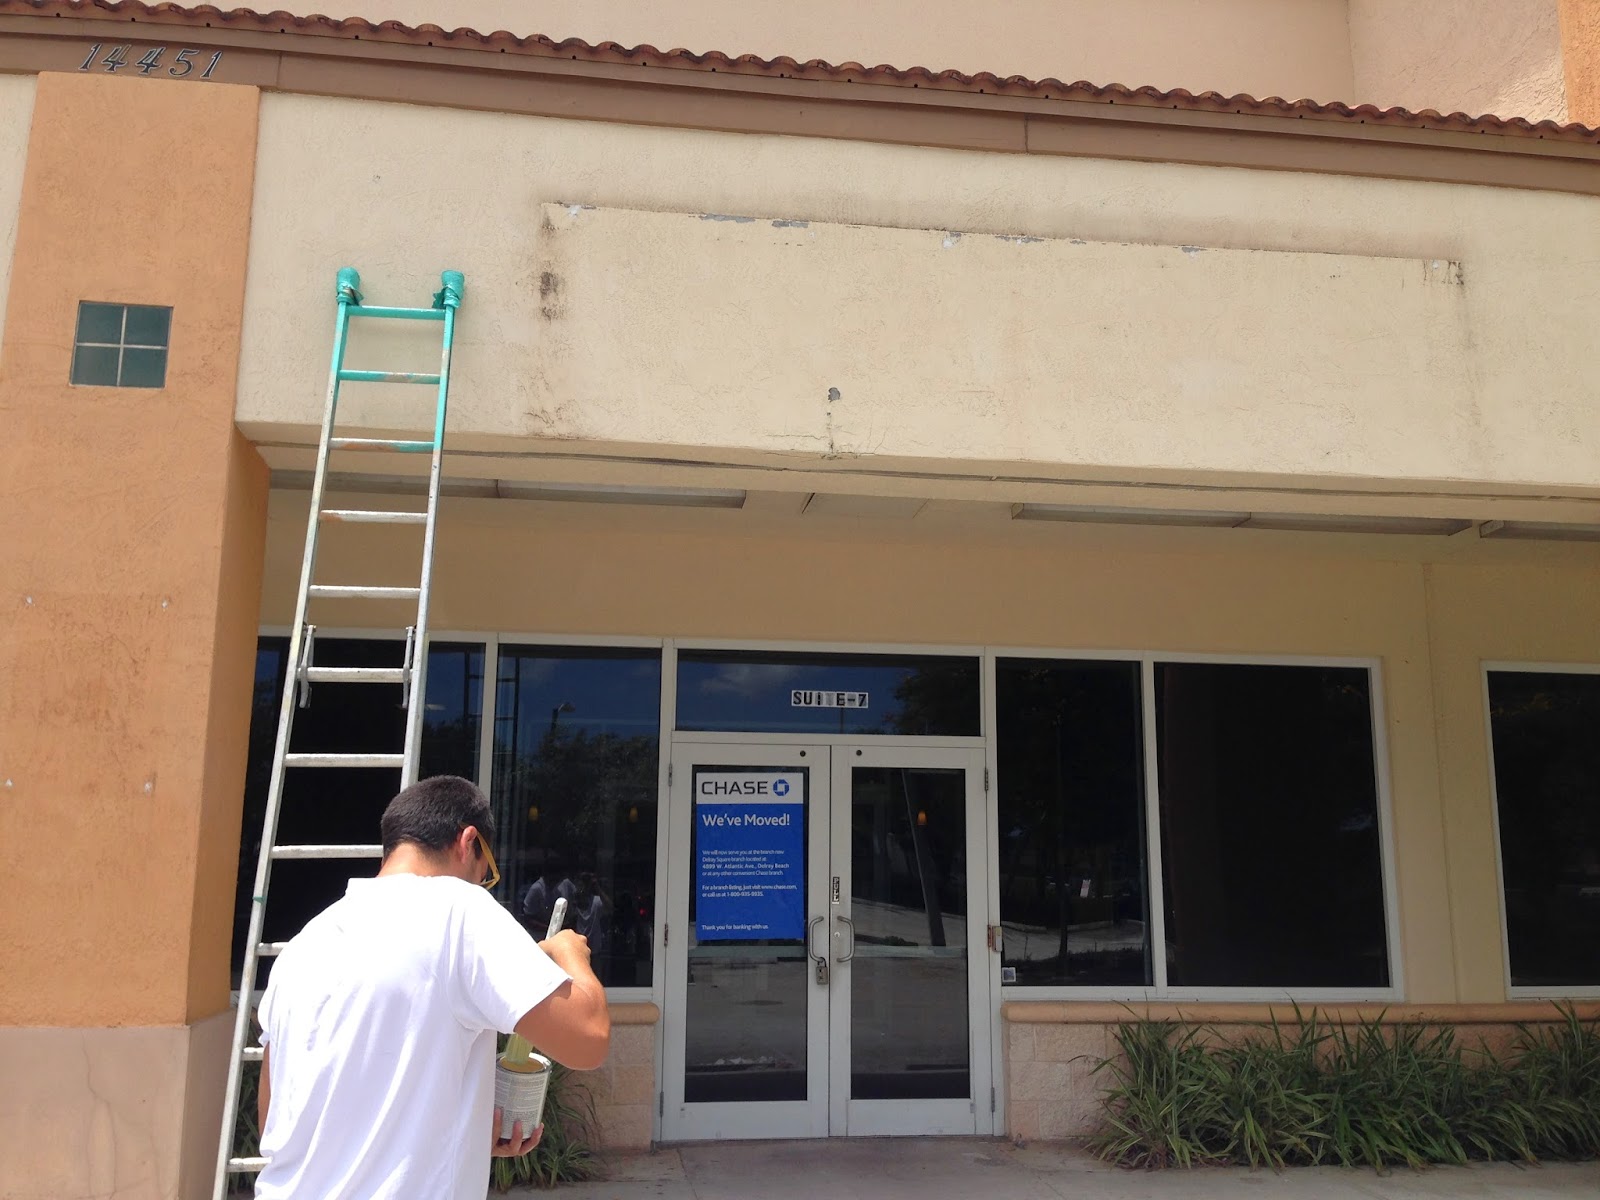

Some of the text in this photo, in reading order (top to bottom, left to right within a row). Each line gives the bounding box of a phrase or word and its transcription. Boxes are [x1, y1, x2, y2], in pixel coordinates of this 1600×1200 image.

[78, 43, 222, 79] 14451
[793, 691, 867, 707] SUIE-7
[701, 781, 768, 795] CHASE
[702, 813, 790, 826] We've Moved!
